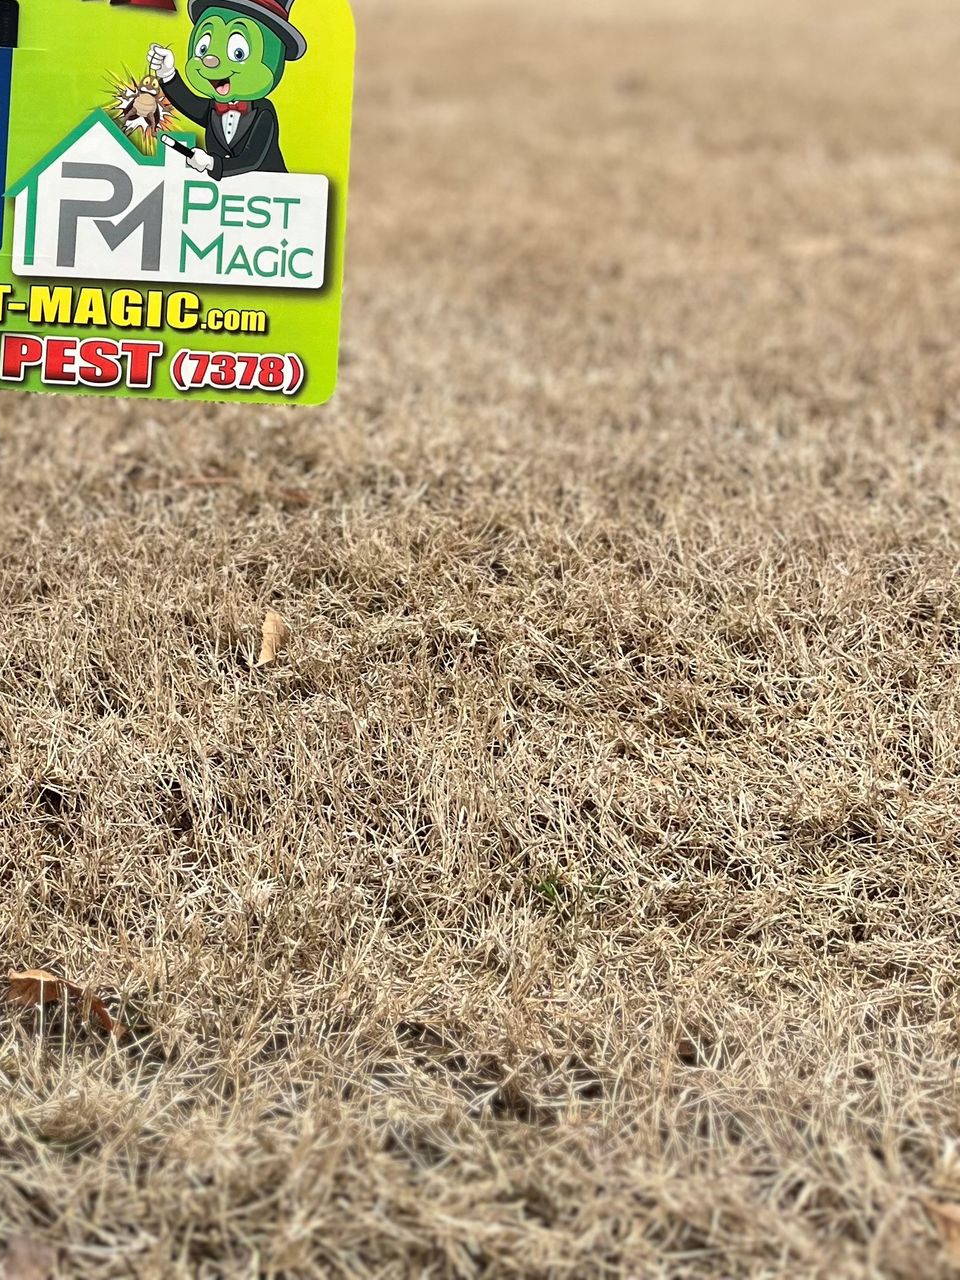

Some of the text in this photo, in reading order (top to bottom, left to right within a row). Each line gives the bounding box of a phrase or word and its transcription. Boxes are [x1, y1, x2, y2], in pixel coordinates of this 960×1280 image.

[181, 180, 301, 230] PEST
[0, 333, 164, 389] PEST
[170, 348, 304, 394] (7378)
